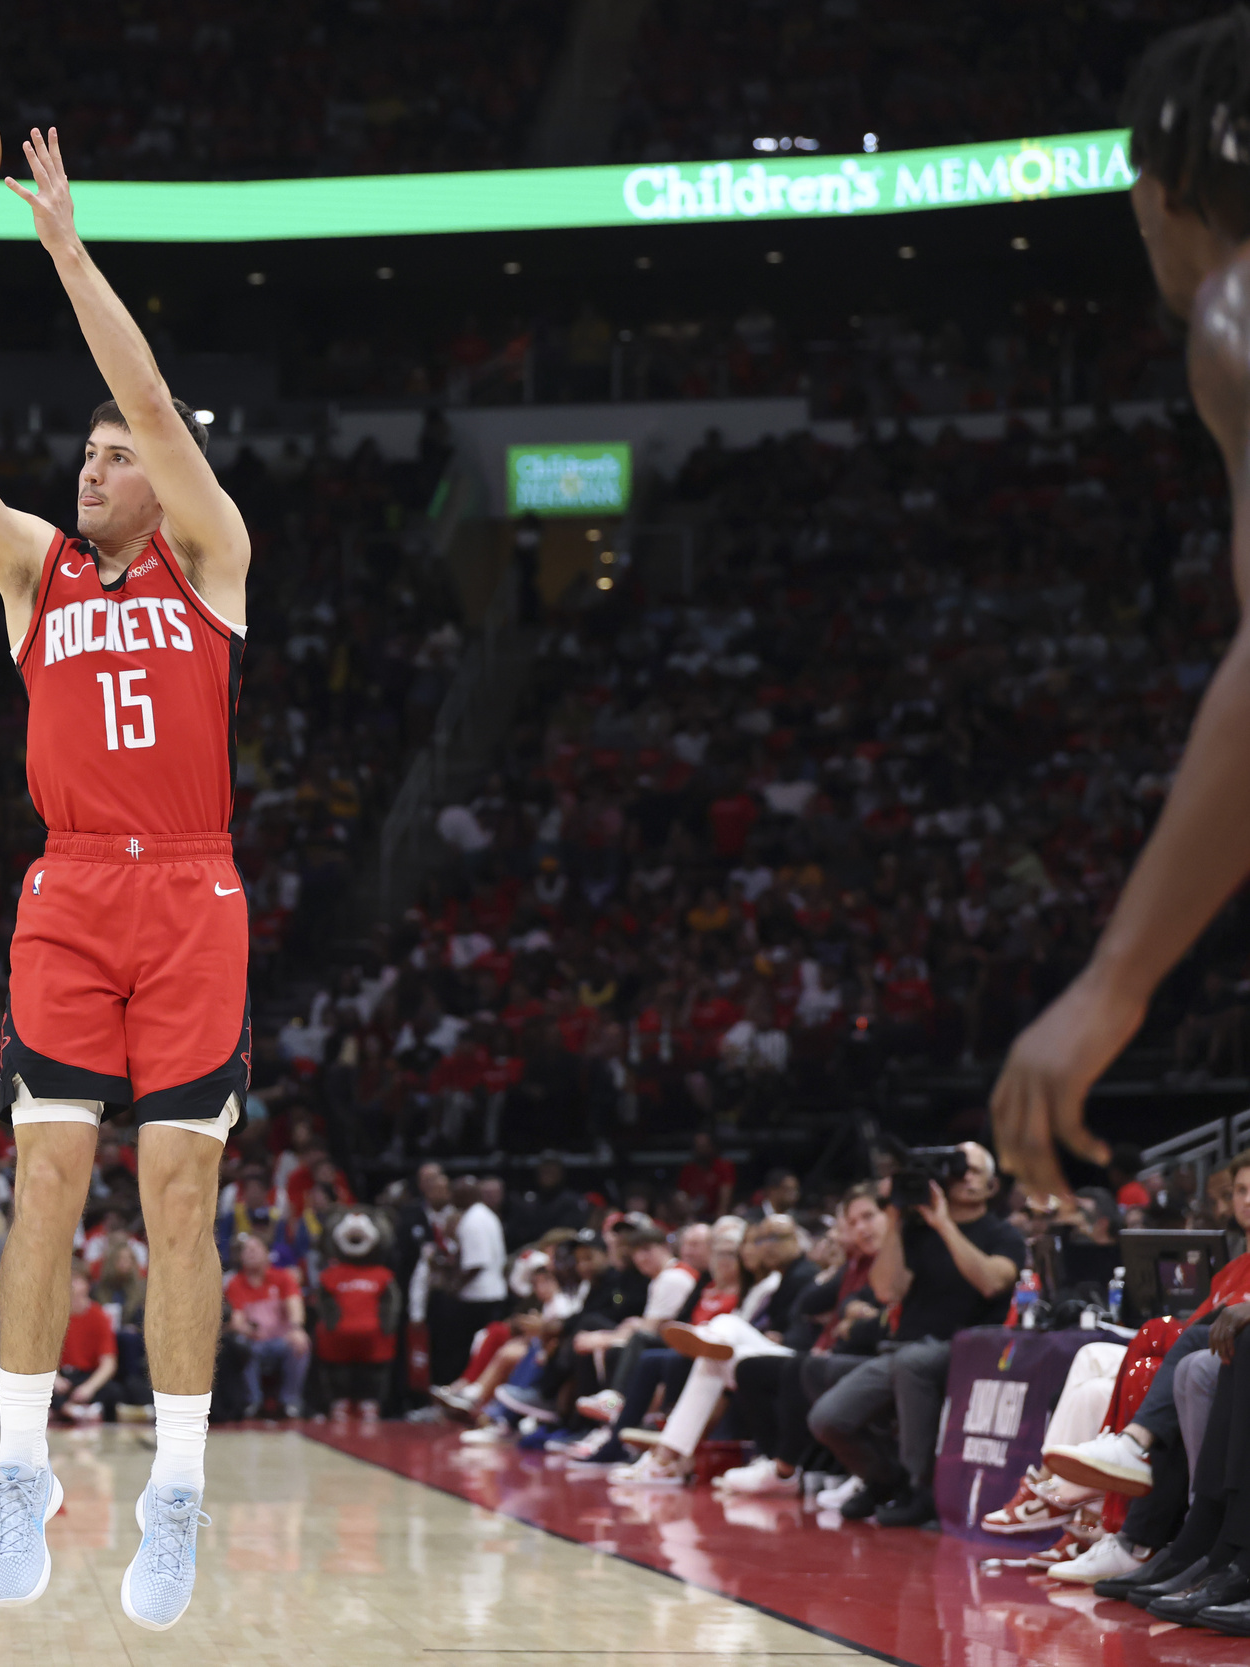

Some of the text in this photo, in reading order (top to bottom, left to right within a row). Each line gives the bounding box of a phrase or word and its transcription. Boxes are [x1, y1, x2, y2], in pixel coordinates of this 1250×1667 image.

[623, 142, 1141, 219] Children's MEMORIA
[44, 596, 194, 667] ROCKETS
[96, 668, 156, 751] 15
